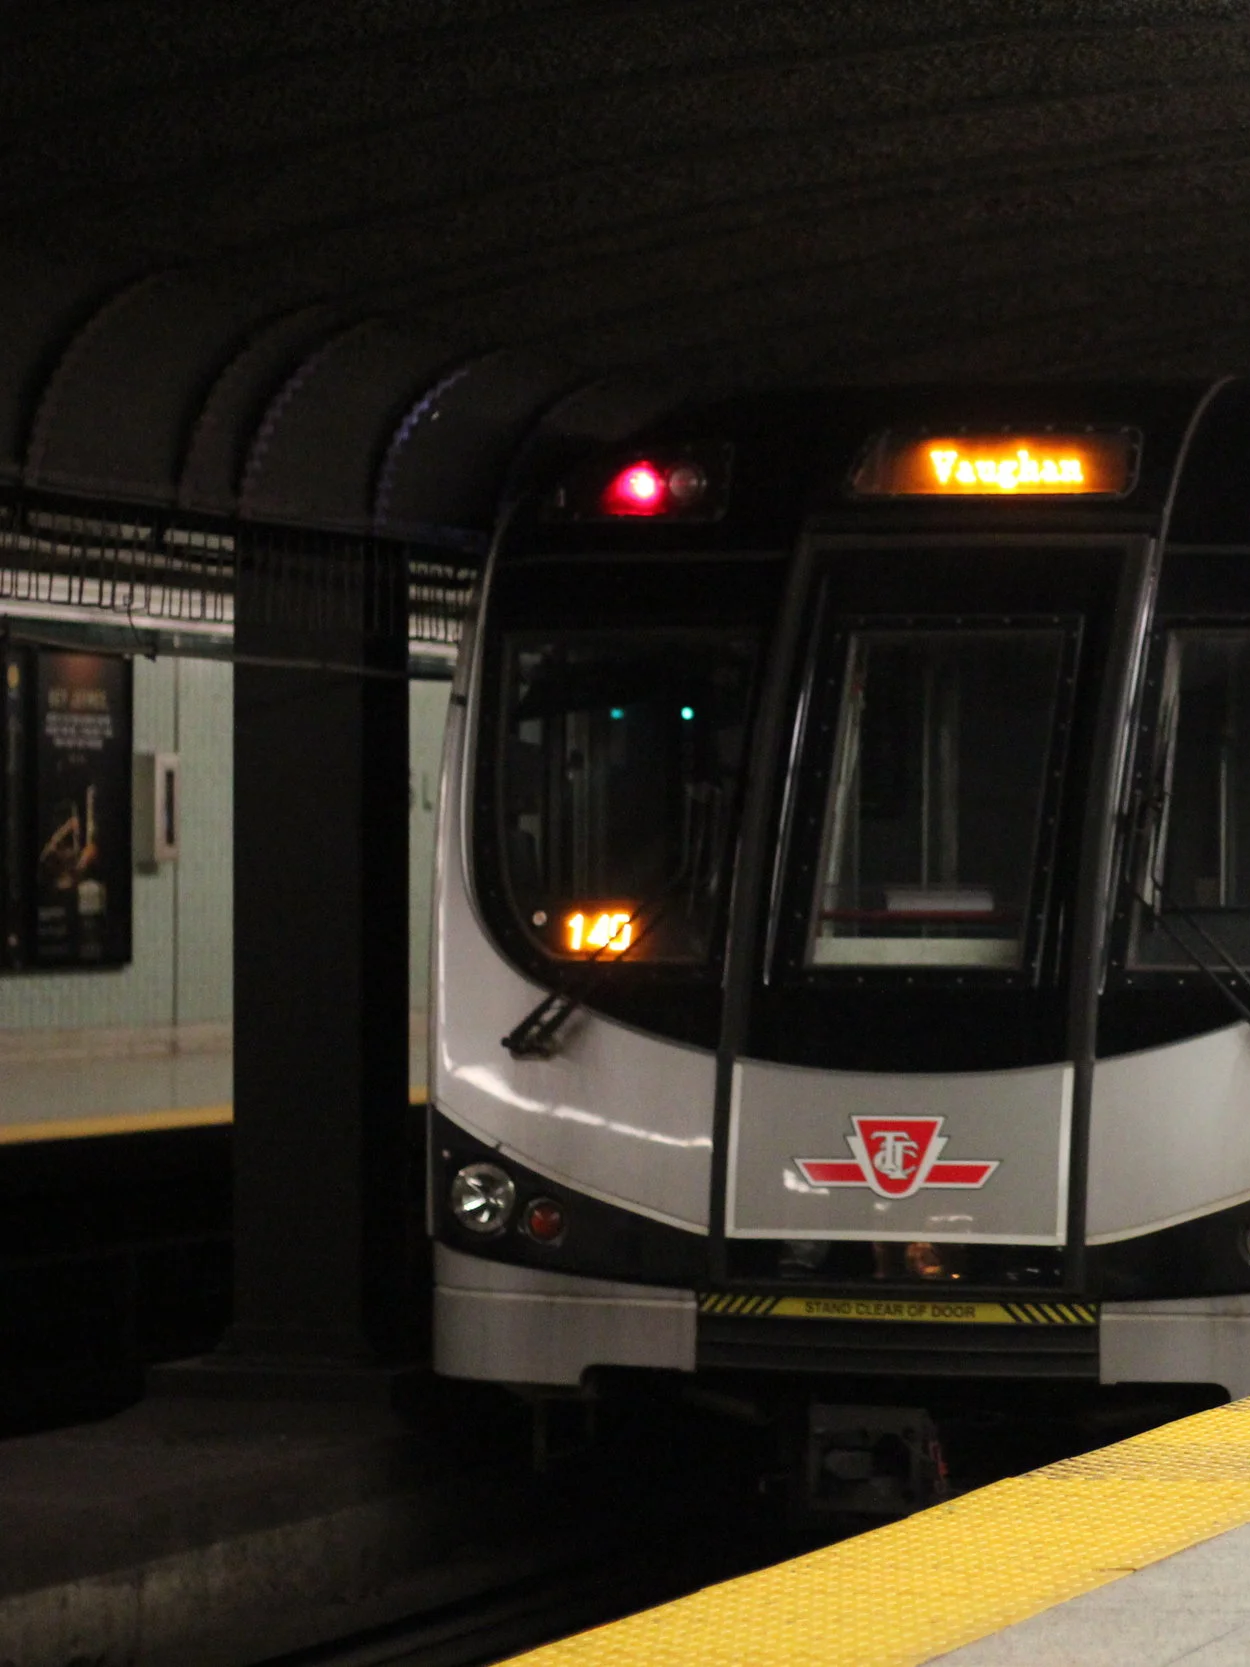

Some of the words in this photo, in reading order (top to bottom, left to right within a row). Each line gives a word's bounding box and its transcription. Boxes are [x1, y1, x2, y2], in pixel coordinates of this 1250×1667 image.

[929, 449, 1084, 489] Vaughan
[804, 1300, 851, 1315] STAND
[855, 1302, 905, 1317] CLEAR
[906, 1303, 927, 1318] OF
[931, 1304, 976, 1319] DOOR
